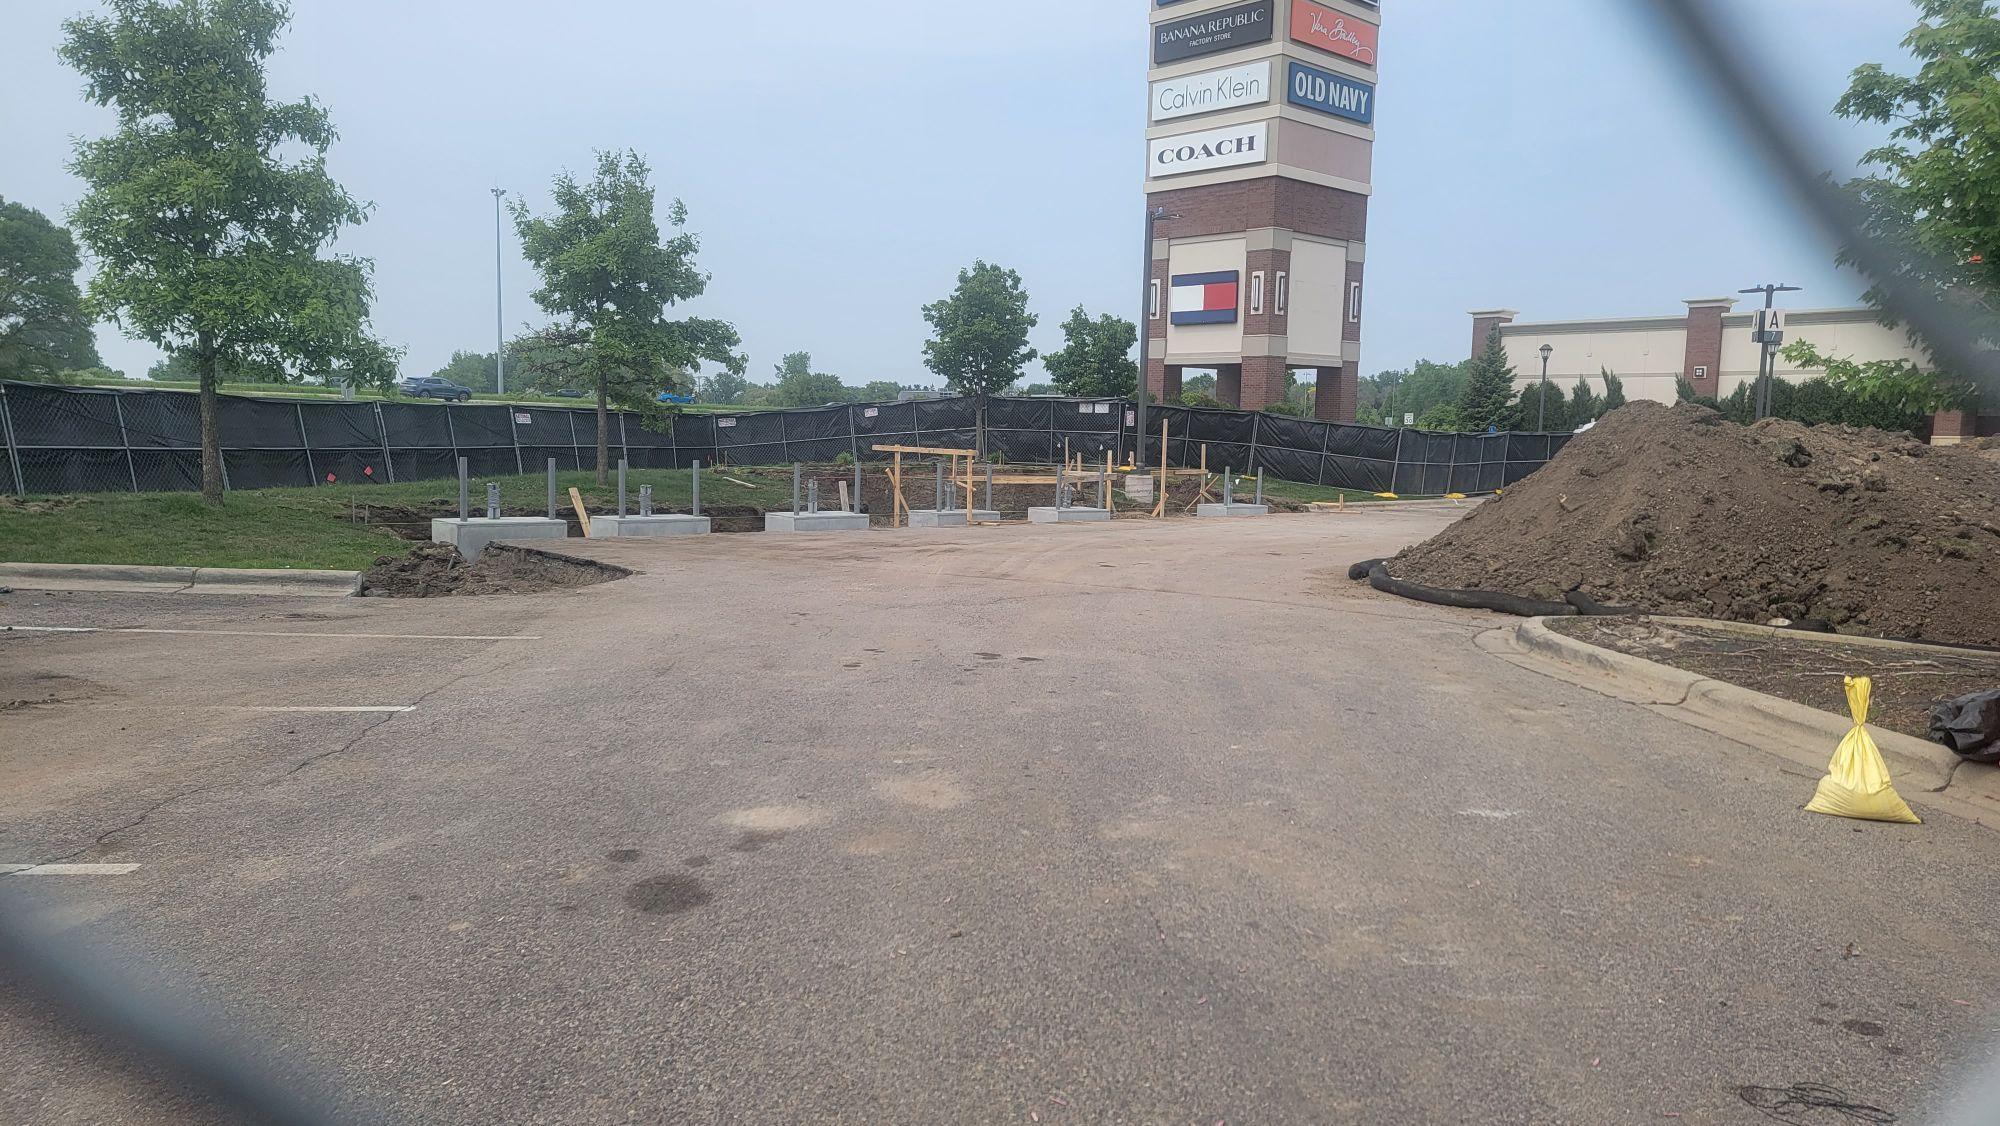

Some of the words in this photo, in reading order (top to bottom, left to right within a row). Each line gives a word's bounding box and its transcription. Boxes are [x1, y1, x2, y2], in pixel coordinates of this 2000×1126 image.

[1160, 25, 1206, 44] BANANA
[1208, 8, 1265, 33] REPUBLIC
[1189, 36, 1213, 47] FACTORY
[1213, 31, 1232, 43] STORE
[1310, 10, 1328, 35] Vera
[1328, 18, 1374, 63] Bradley
[1160, 81, 1212, 111] Calvin
[1217, 72, 1260, 102] Klein
[1295, 71, 1326, 102] OLD
[1328, 81, 1369, 114] NAVY
[1157, 135, 1256, 164] COACH
[1769, 310, 1779, 329] A
